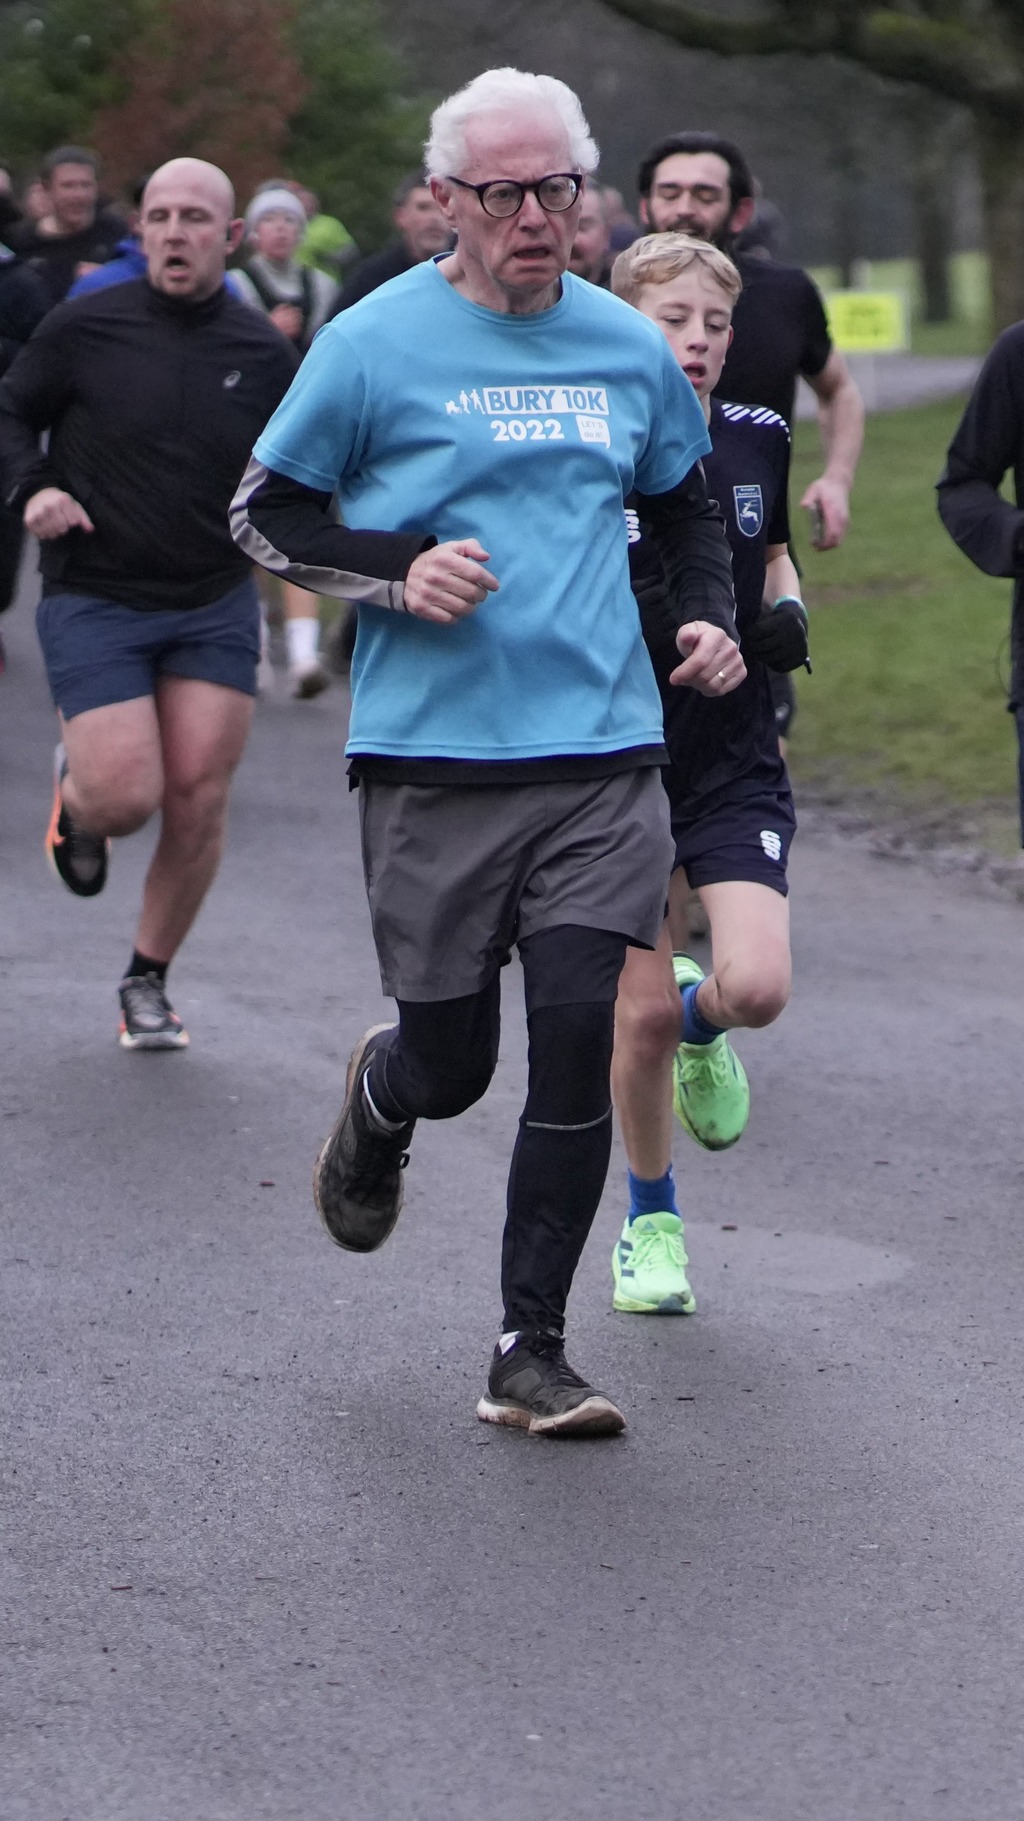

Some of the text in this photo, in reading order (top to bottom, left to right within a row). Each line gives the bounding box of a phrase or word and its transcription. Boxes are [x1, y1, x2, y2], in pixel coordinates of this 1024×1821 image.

[488, 389, 605, 411] BURY 10K
[490, 419, 564, 441] 2022
